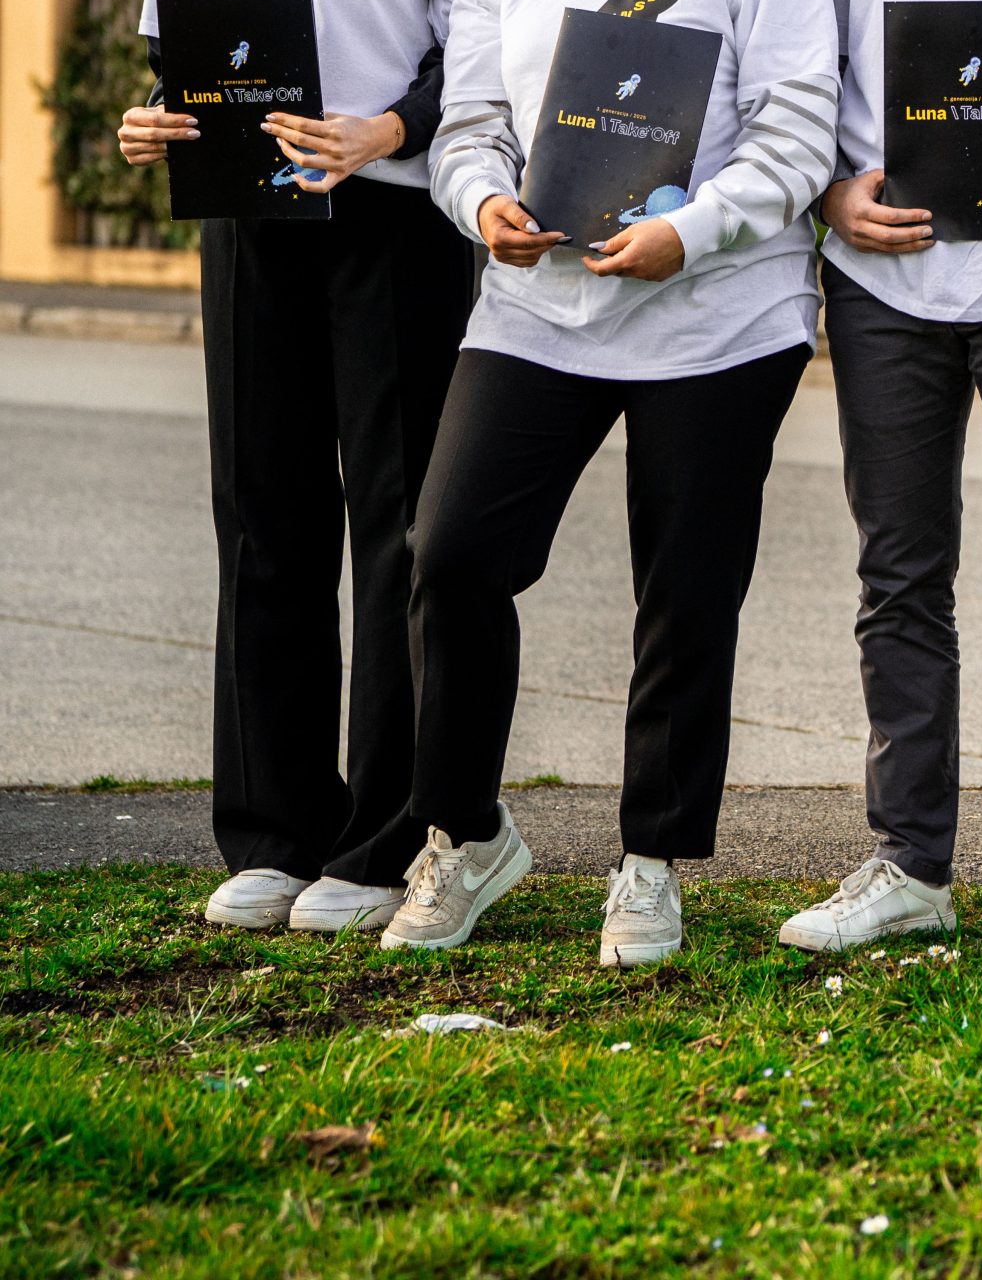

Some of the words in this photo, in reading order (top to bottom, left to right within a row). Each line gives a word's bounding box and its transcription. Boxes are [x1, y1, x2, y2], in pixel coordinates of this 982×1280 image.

[183, 89, 222, 104] Luna
[275, 87, 303, 102] Off
[906, 106, 947, 120] Luna
[557, 109, 596, 129] Luna
[651, 126, 681, 145] Off
